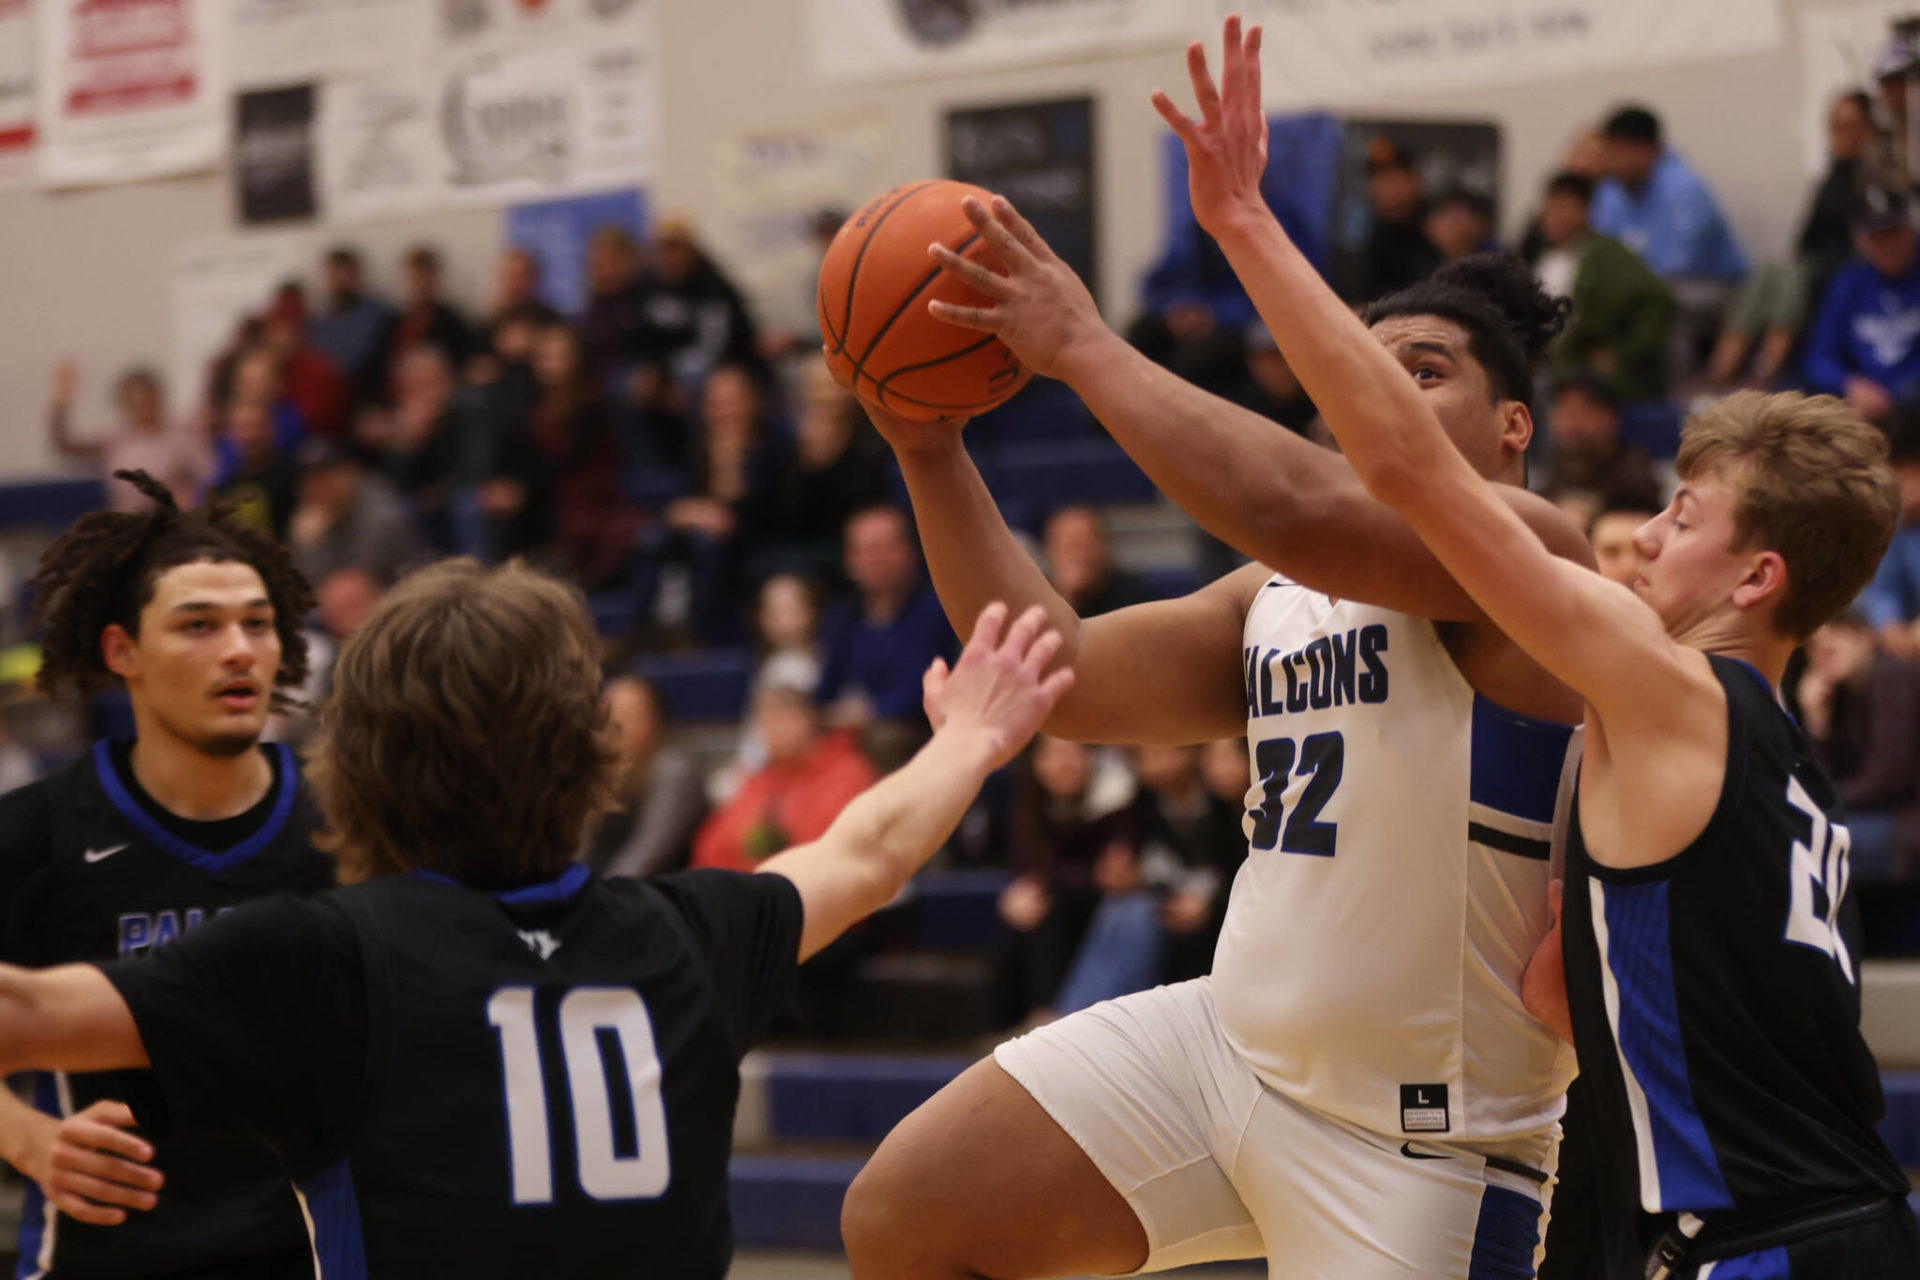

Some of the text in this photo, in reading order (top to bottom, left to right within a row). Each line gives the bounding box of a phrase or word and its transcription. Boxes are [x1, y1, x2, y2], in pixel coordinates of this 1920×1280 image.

[1245, 624, 1388, 719] ALCONS
[1248, 730, 1344, 857] 32
[485, 985, 671, 1205] 10
[1417, 1089, 1430, 1104] L
